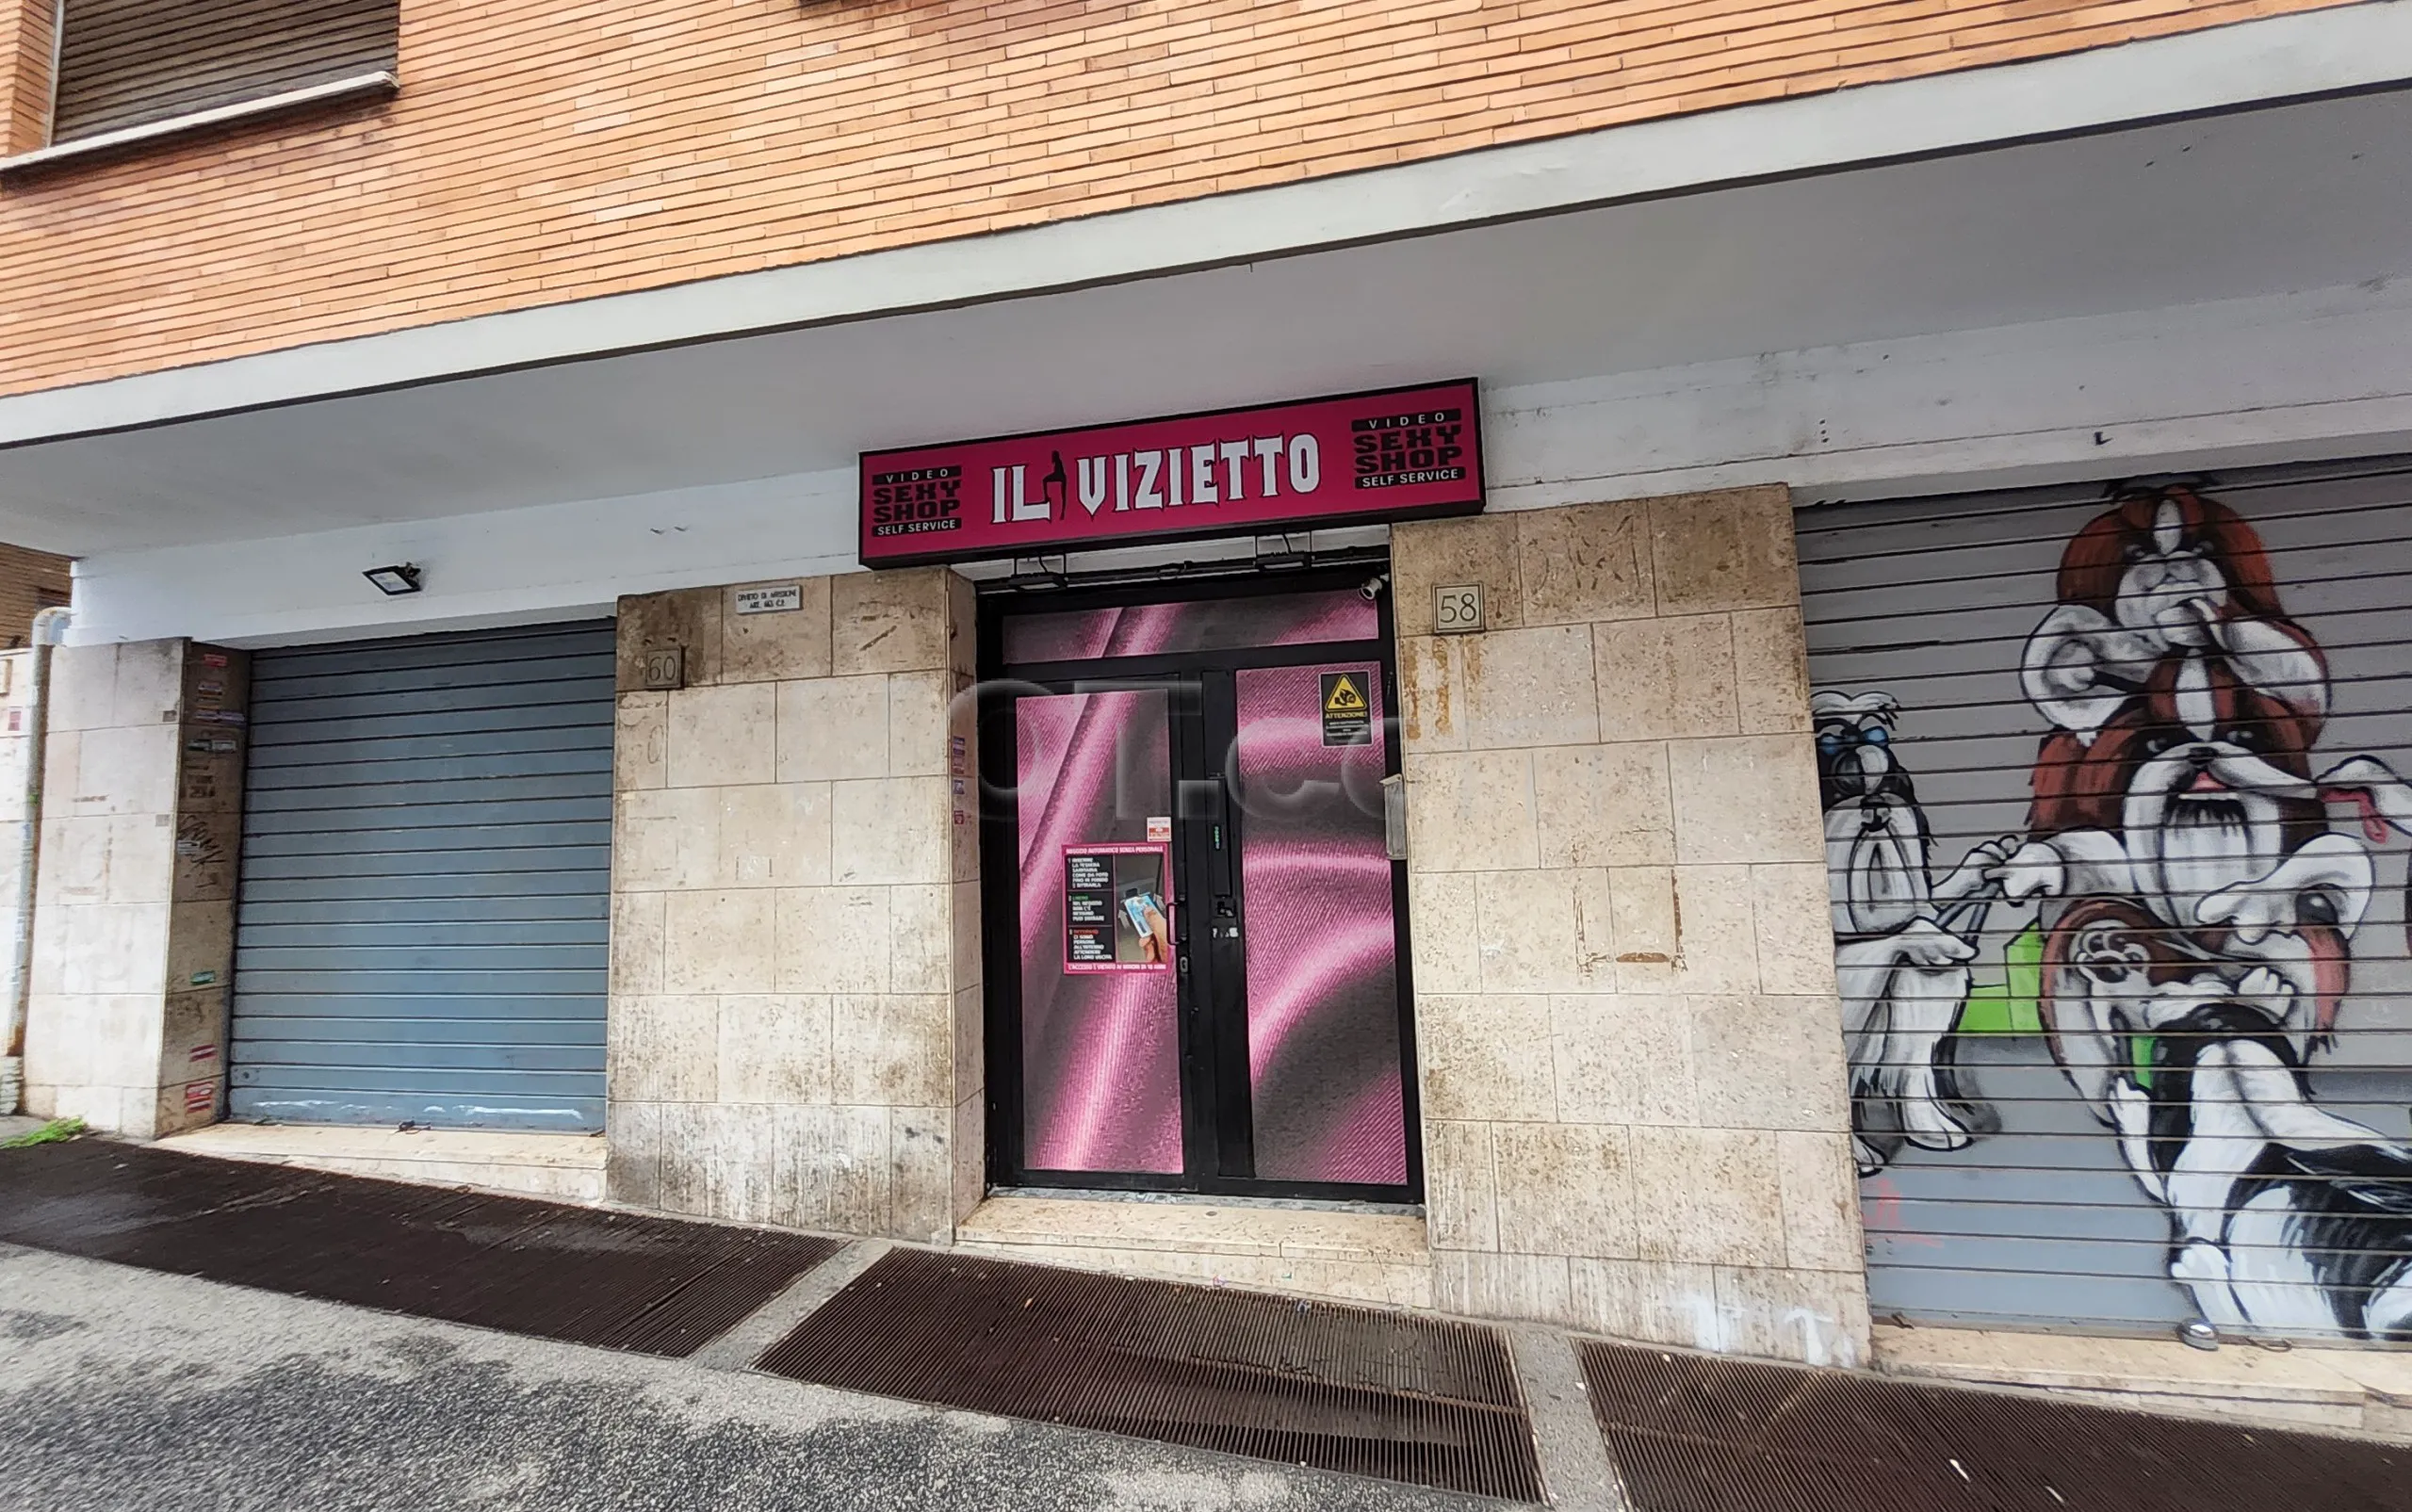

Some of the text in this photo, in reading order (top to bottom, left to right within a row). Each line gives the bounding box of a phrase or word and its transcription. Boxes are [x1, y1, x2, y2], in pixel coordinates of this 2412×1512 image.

[1369, 412, 1444, 430] VIDEO
[1354, 424, 1462, 454] SEXY
[1354, 447, 1463, 474] SHOP
[886, 468, 948, 484] VIDEO
[992, 433, 1320, 524] IL VIZIETTO
[1362, 468, 1459, 487] SELF SERVICE
[872, 480, 960, 505] SEXY
[873, 499, 960, 523] SHOP
[877, 519, 955, 536] SELF SERVICE
[1440, 593, 1476, 624] 58
[649, 656, 676, 681] 60
